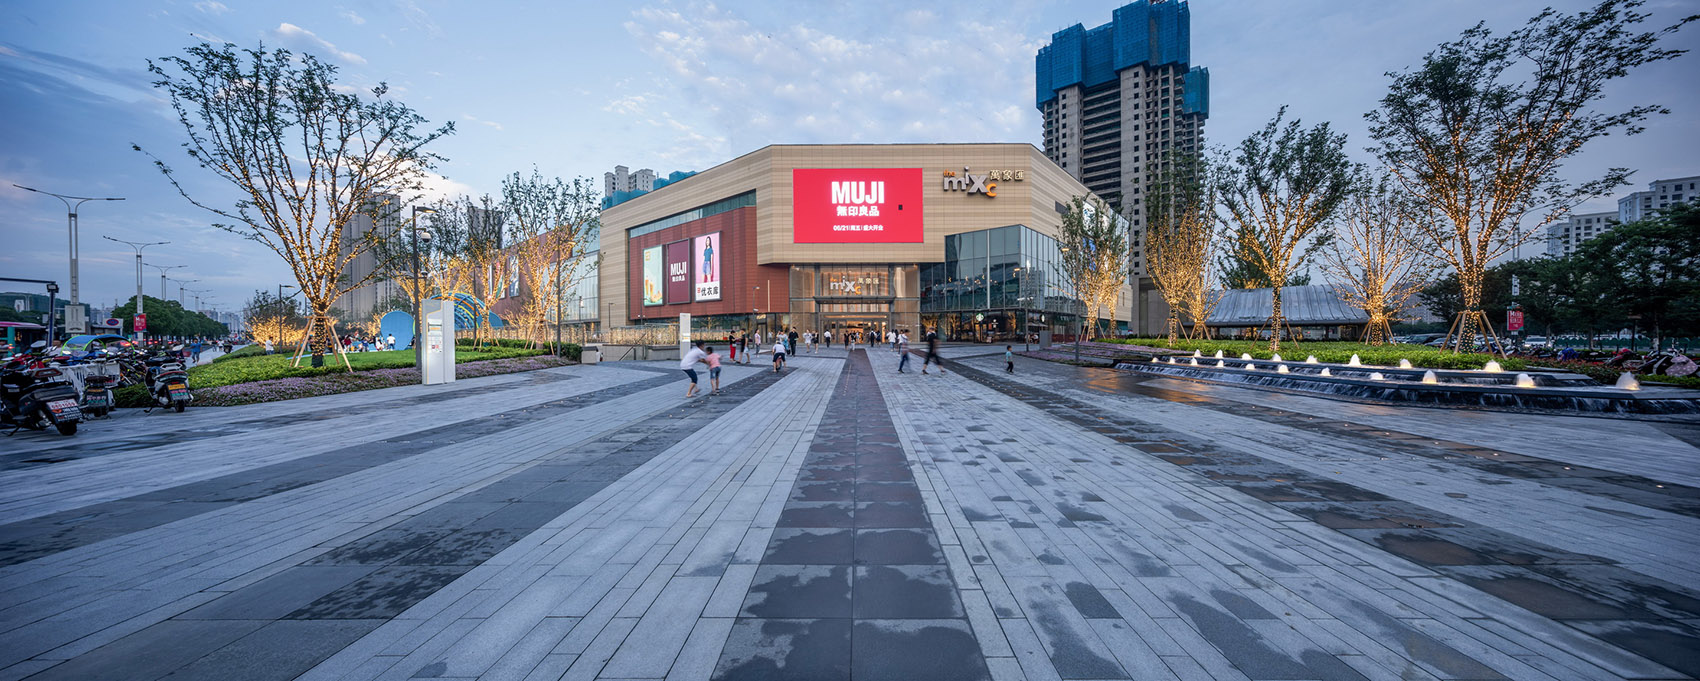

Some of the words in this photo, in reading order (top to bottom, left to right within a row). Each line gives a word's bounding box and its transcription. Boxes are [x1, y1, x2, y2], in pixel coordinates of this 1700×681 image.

[831, 181, 885, 204] MUJI
[836, 205, 880, 217] 無印良品
[670, 261, 687, 276] MUJI
[700, 286, 719, 296] 优衣库
